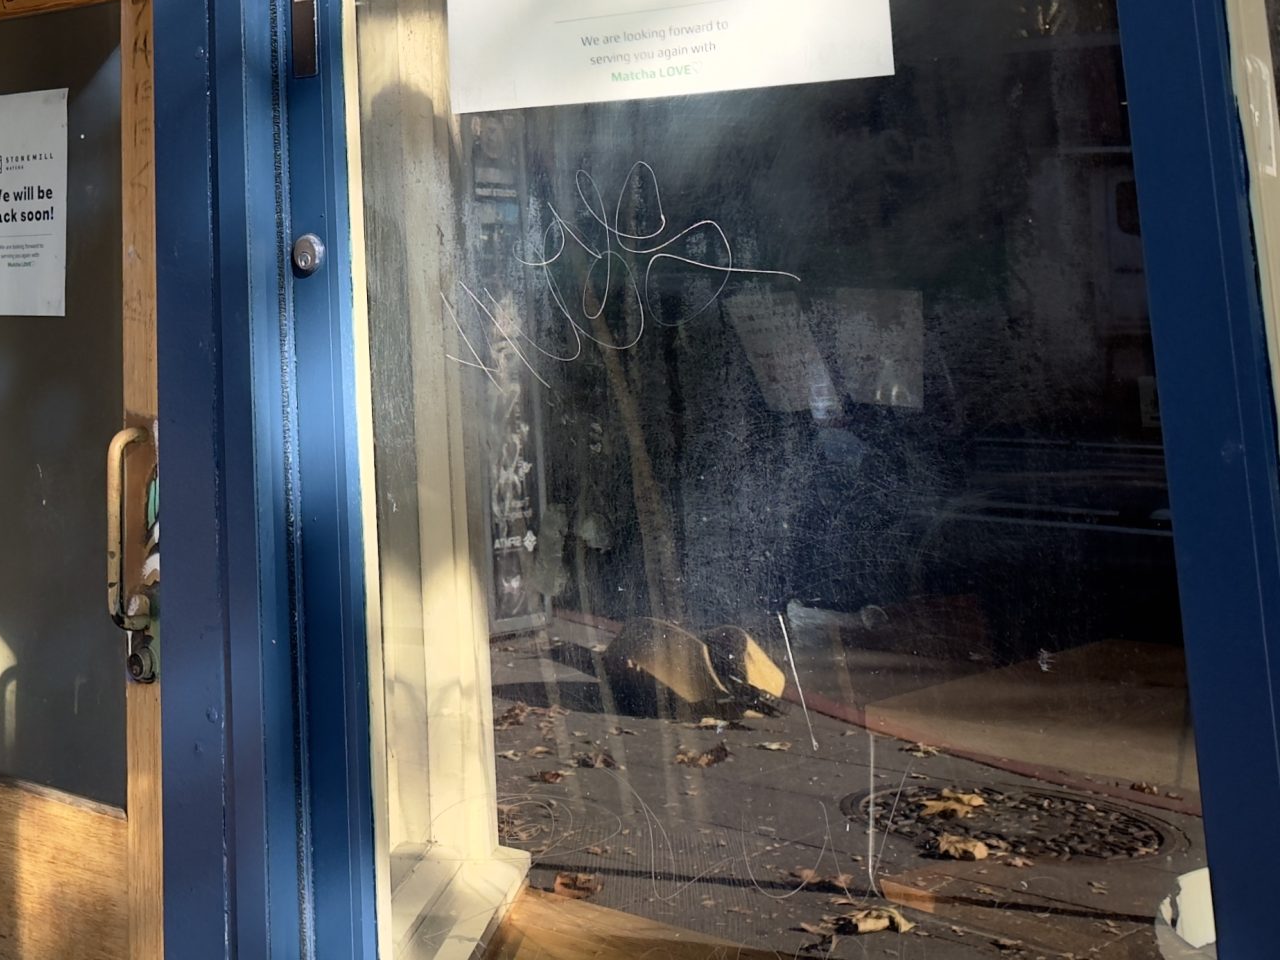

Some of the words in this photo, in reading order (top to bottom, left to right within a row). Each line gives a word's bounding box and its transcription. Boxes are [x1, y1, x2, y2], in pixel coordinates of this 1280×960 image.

[581, 36, 600, 47] We
[602, 34, 621, 45] are
[623, 27, 666, 41] looking
[668, 20, 713, 37] forward
[716, 20, 729, 31] to
[589, 52, 631, 65] serving
[633, 51, 655, 62] you
[657, 45, 688, 61] again
[691, 41, 716, 55] with
[610, 68, 656, 83] Matcha
[659, 64, 691, 78] LOVE
[6, 152, 54, 164] STONEMILL
[13, 186, 34, 201] will
[37, 185, 53, 200] be
[20, 206, 54, 222] soon!
